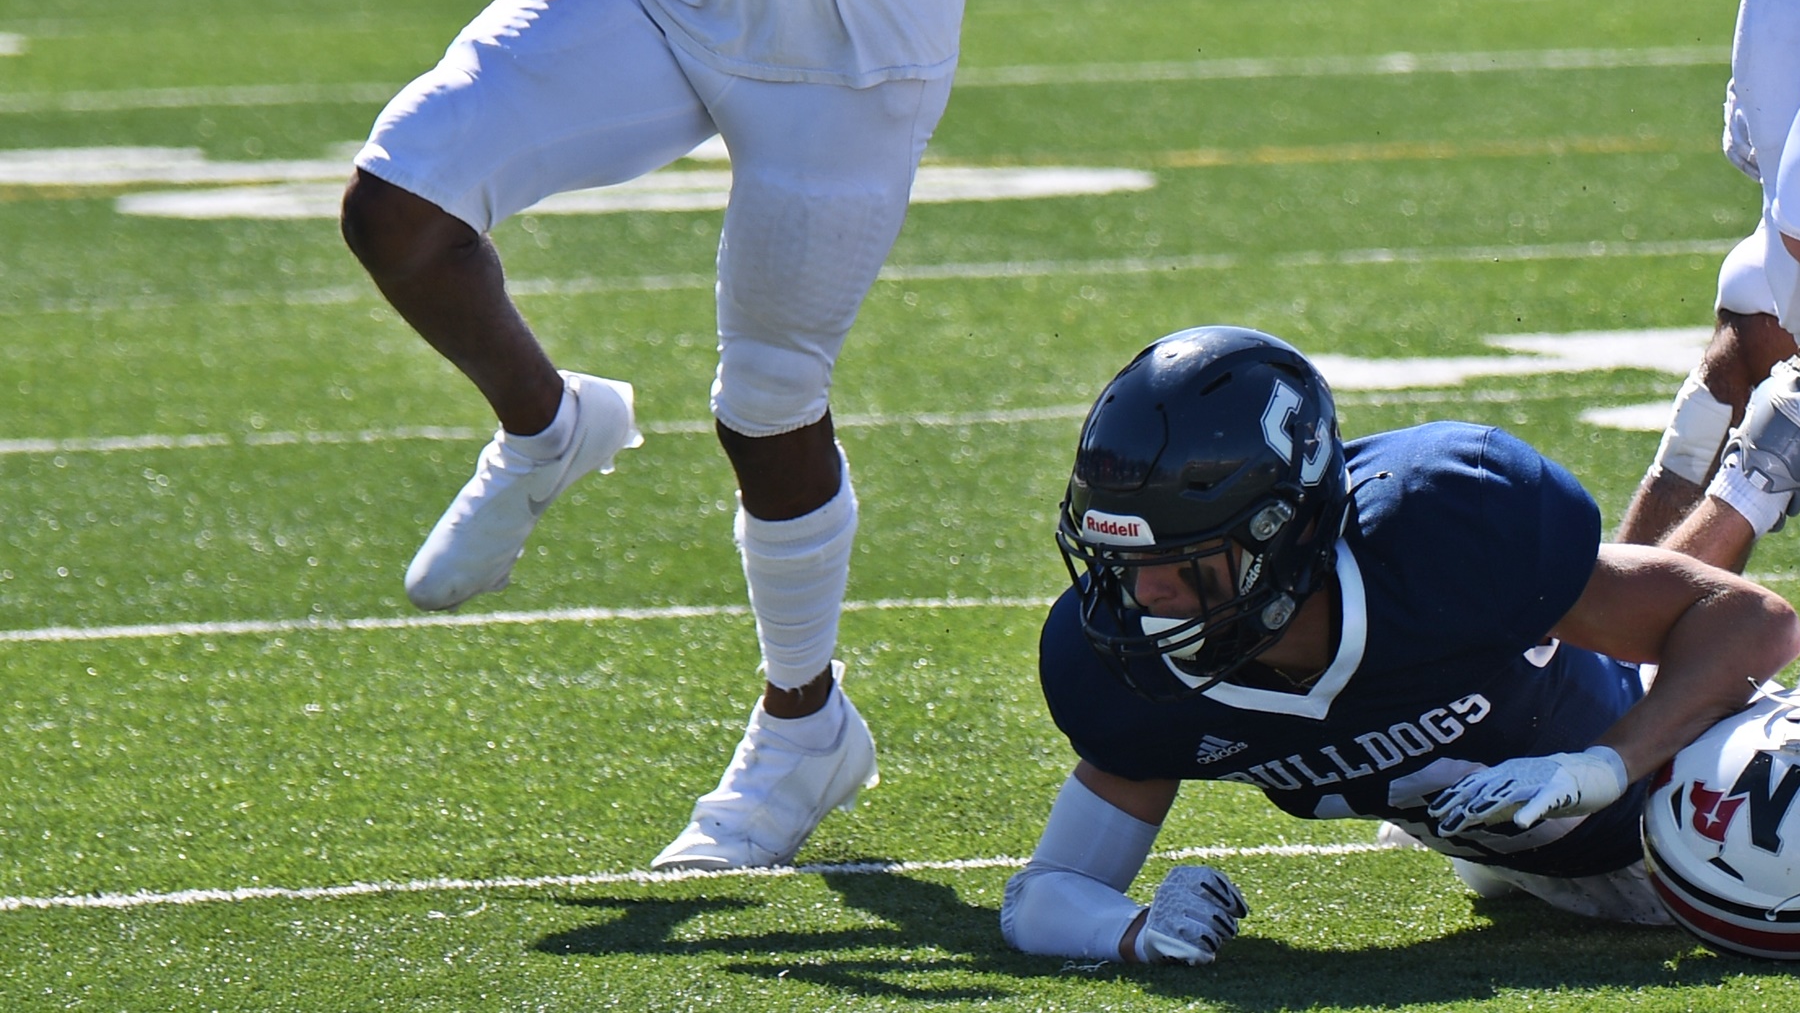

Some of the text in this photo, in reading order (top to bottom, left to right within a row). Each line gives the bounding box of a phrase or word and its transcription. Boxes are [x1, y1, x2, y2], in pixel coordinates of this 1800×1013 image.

[1260, 378, 1334, 487] C
[1086, 516, 1140, 537] Riddell
[1196, 740, 1249, 765] adidas
